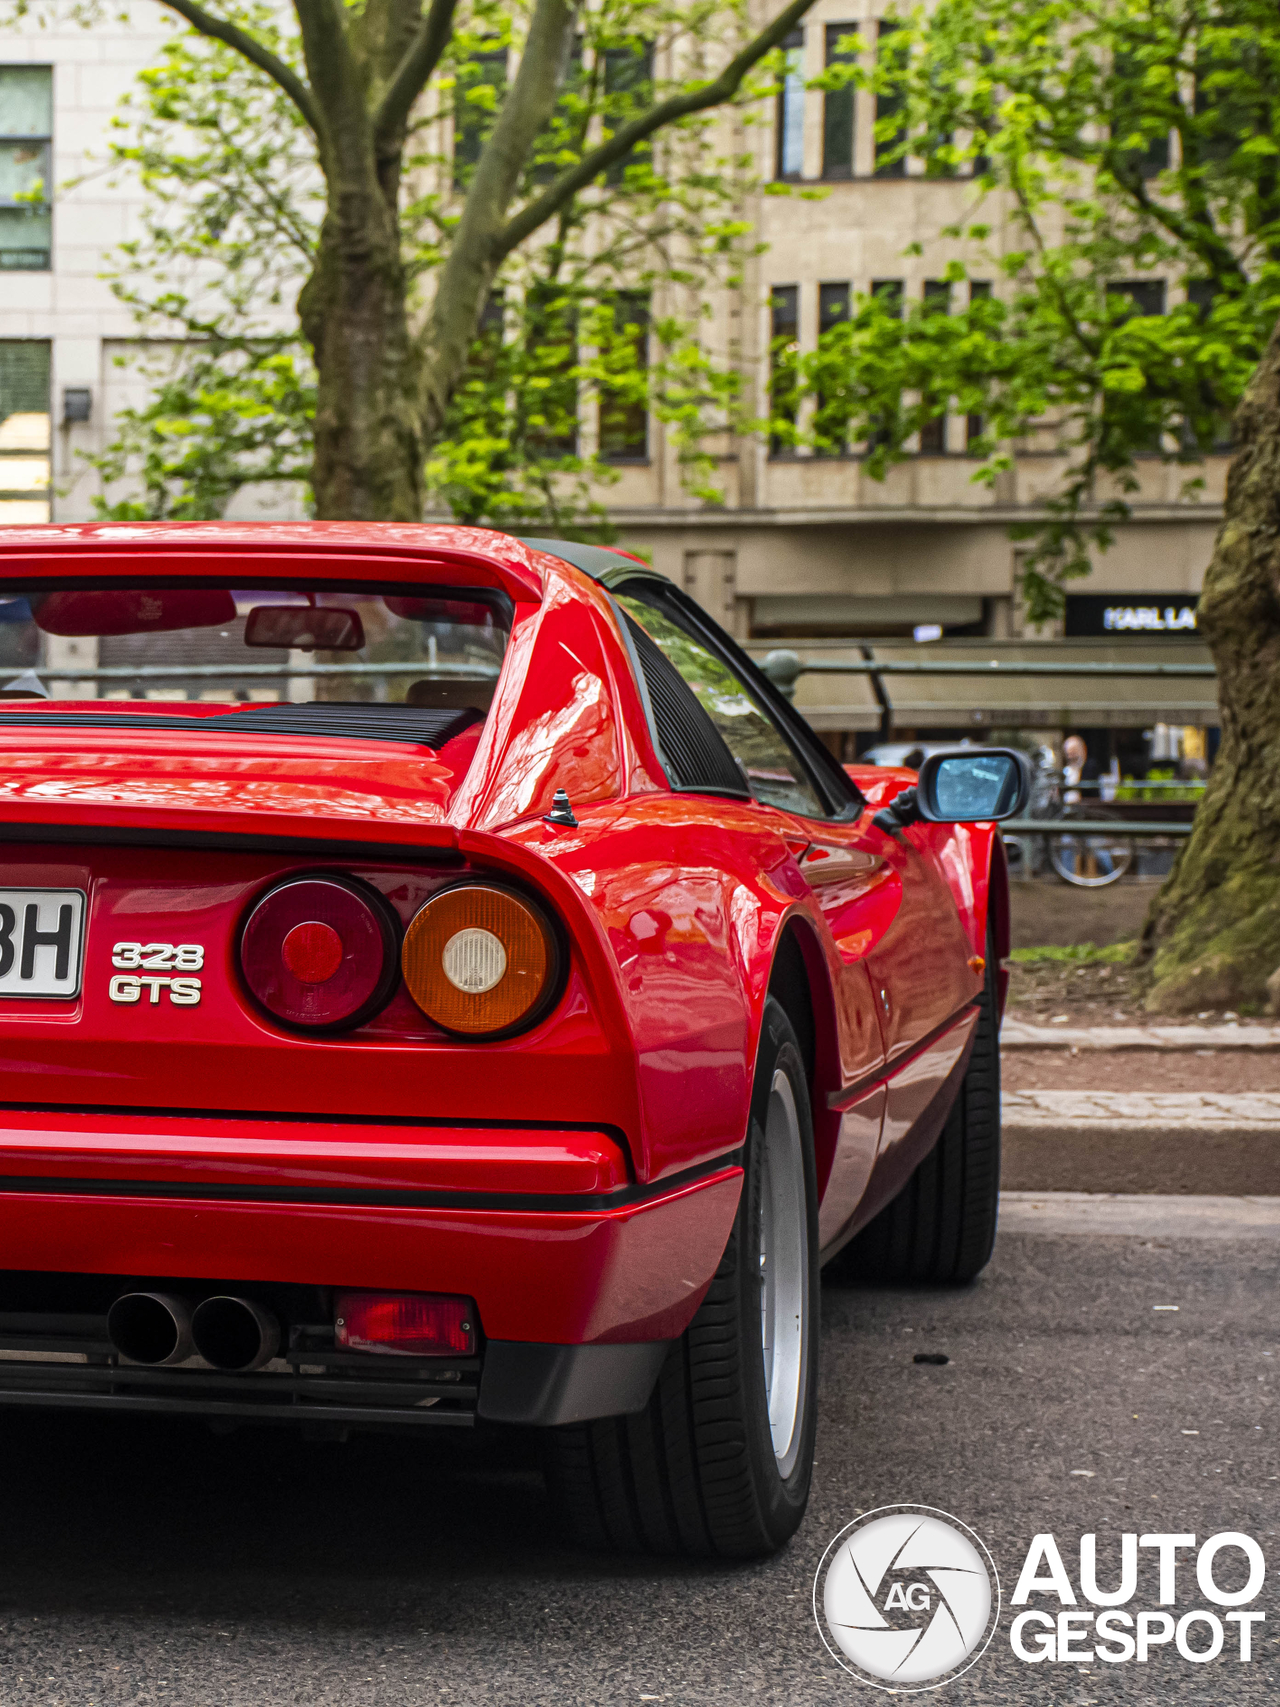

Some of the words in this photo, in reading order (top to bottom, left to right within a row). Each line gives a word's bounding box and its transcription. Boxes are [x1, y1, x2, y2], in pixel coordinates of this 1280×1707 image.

[1104, 606, 1164, 630] KARL
[1165, 606, 1198, 630] LA
[111, 941, 205, 971] 328
[109, 974, 202, 1005] GTS
